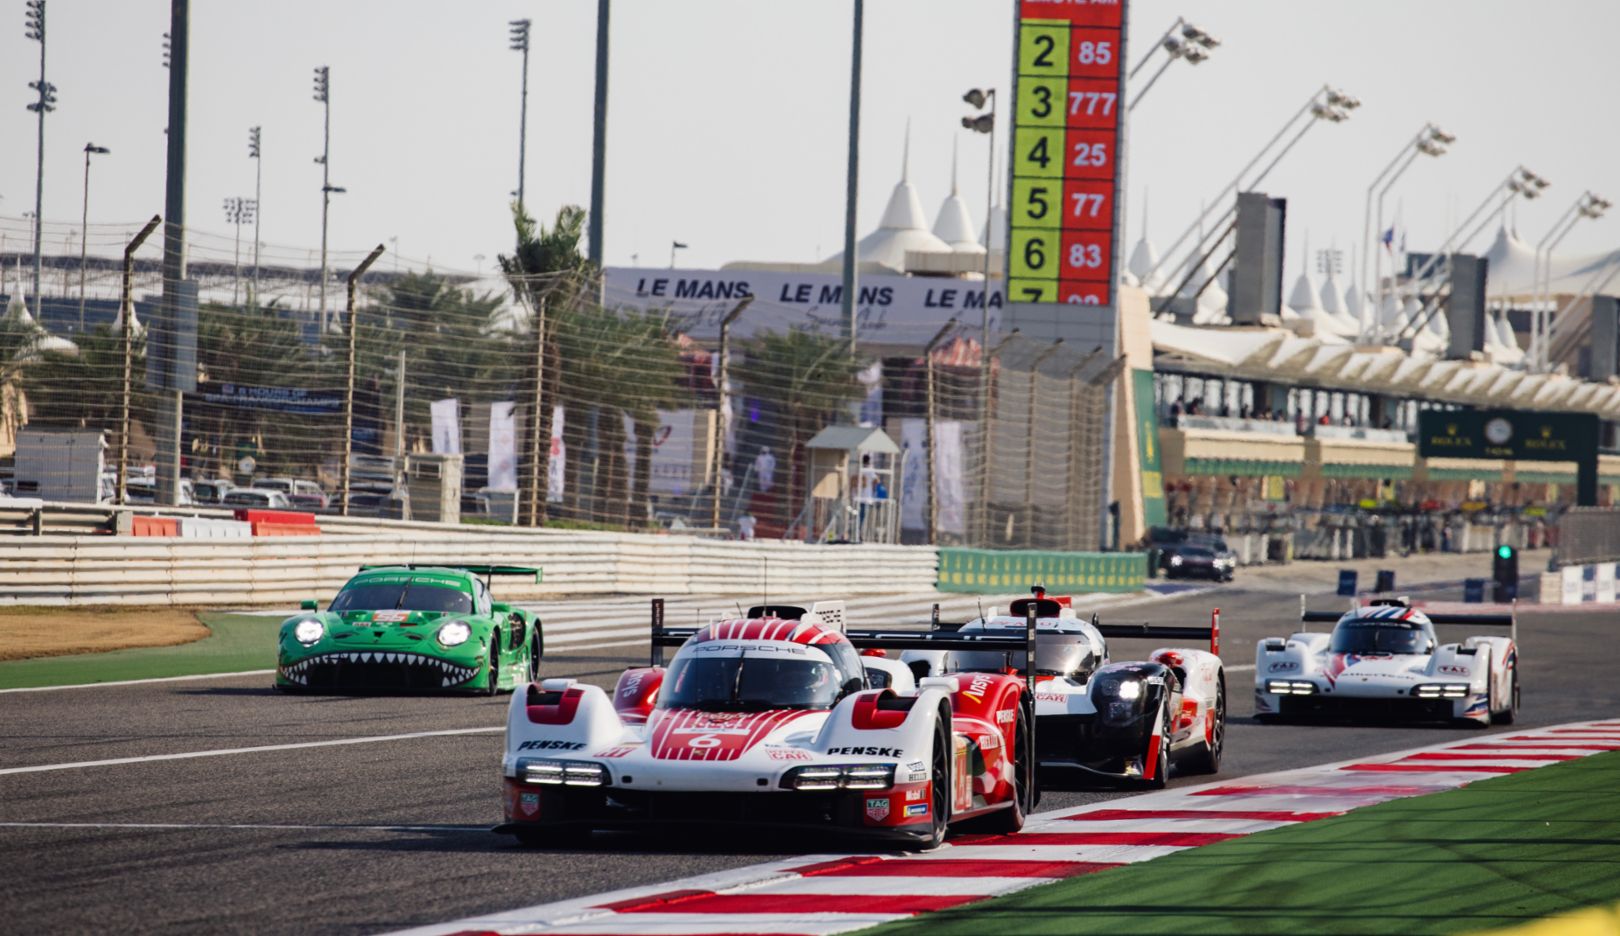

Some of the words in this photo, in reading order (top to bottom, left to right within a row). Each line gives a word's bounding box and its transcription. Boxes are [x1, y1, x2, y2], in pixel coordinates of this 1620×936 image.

[1032, 35, 1055, 67] 2
[1078, 41, 1112, 65] 85
[1031, 86, 1053, 118] 3
[1069, 92, 1117, 116] 777
[1027, 136, 1051, 168] 4
[1073, 143, 1107, 166] 25
[1026, 187, 1048, 219] 5
[1071, 193, 1105, 217] 77
[1024, 238, 1046, 270] 6
[1068, 244, 1102, 268] 83
[636, 278, 669, 297] LE
[674, 278, 750, 299] MANS
[779, 283, 813, 303] LE
[818, 284, 894, 306] MNS
[924, 288, 957, 308] LE
[694, 644, 806, 655] PORSCHE
[517, 740, 587, 751] PENSKE
[688, 734, 722, 748] 6
[827, 746, 904, 758] PENSKE
